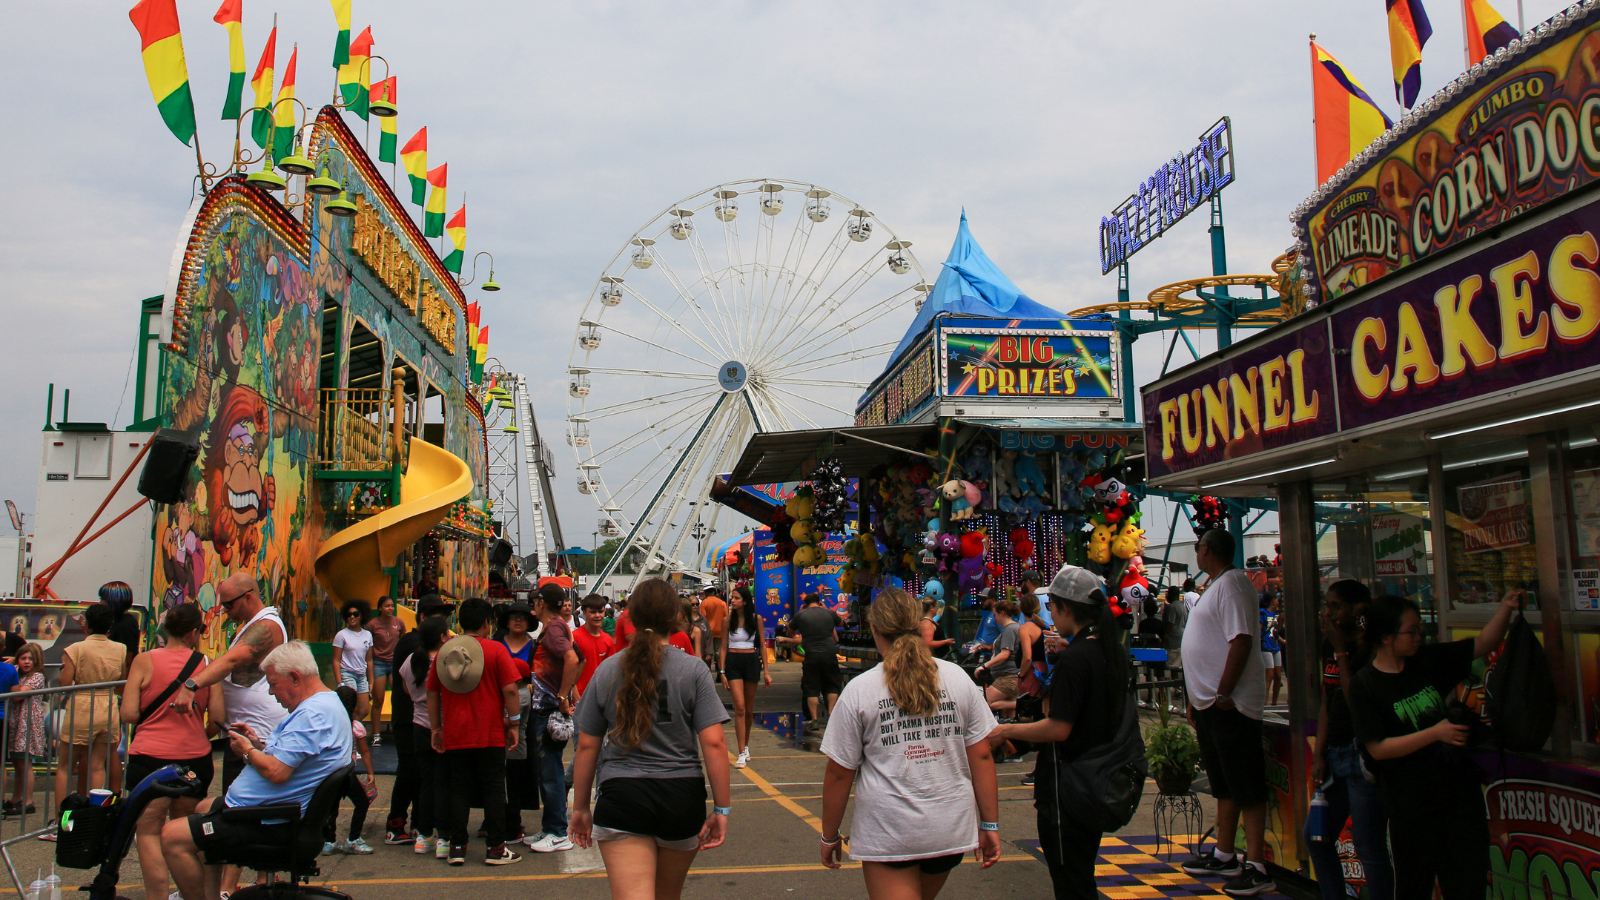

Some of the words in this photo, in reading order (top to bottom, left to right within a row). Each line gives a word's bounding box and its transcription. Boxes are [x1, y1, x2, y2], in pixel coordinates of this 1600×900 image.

[1467, 76, 1544, 137] JUMBO
[1099, 175, 1154, 272] CRAZY
[1154, 122, 1232, 234] MOUSE
[1330, 190, 1370, 218] CHERRY
[1412, 135, 1507, 253] CORN
[1319, 213, 1399, 275] LIMEADE
[998, 336, 1054, 363] BIG
[1158, 348, 1319, 462] FUNNEL
[1350, 231, 1600, 400] CAKES
[977, 367, 1076, 395] PRIZES
[1001, 430, 1055, 448] BIG
[1065, 434, 1129, 448] FUN
[1372, 515, 1401, 533] Cherry
[1463, 525, 1499, 549] FUNNEL
[1499, 519, 1528, 543] CAKES
[816, 540, 842, 550] IDS
[1374, 524, 1422, 560] LIMEADE
[802, 565, 843, 576] EVERY
[1573, 571, 1582, 579] WE
[878, 697, 896, 709] STIC
[880, 711, 895, 722] MAY
[881, 724, 893, 734] BUT
[897, 718, 922, 730] PARMA
[924, 714, 957, 726] HOSPITAL
[881, 736, 900, 746] WILL
[903, 731, 921, 742] TAKE
[925, 728, 940, 738] CARE
[944, 727, 951, 736] OF
[1498, 790, 1547, 823] FRESH
